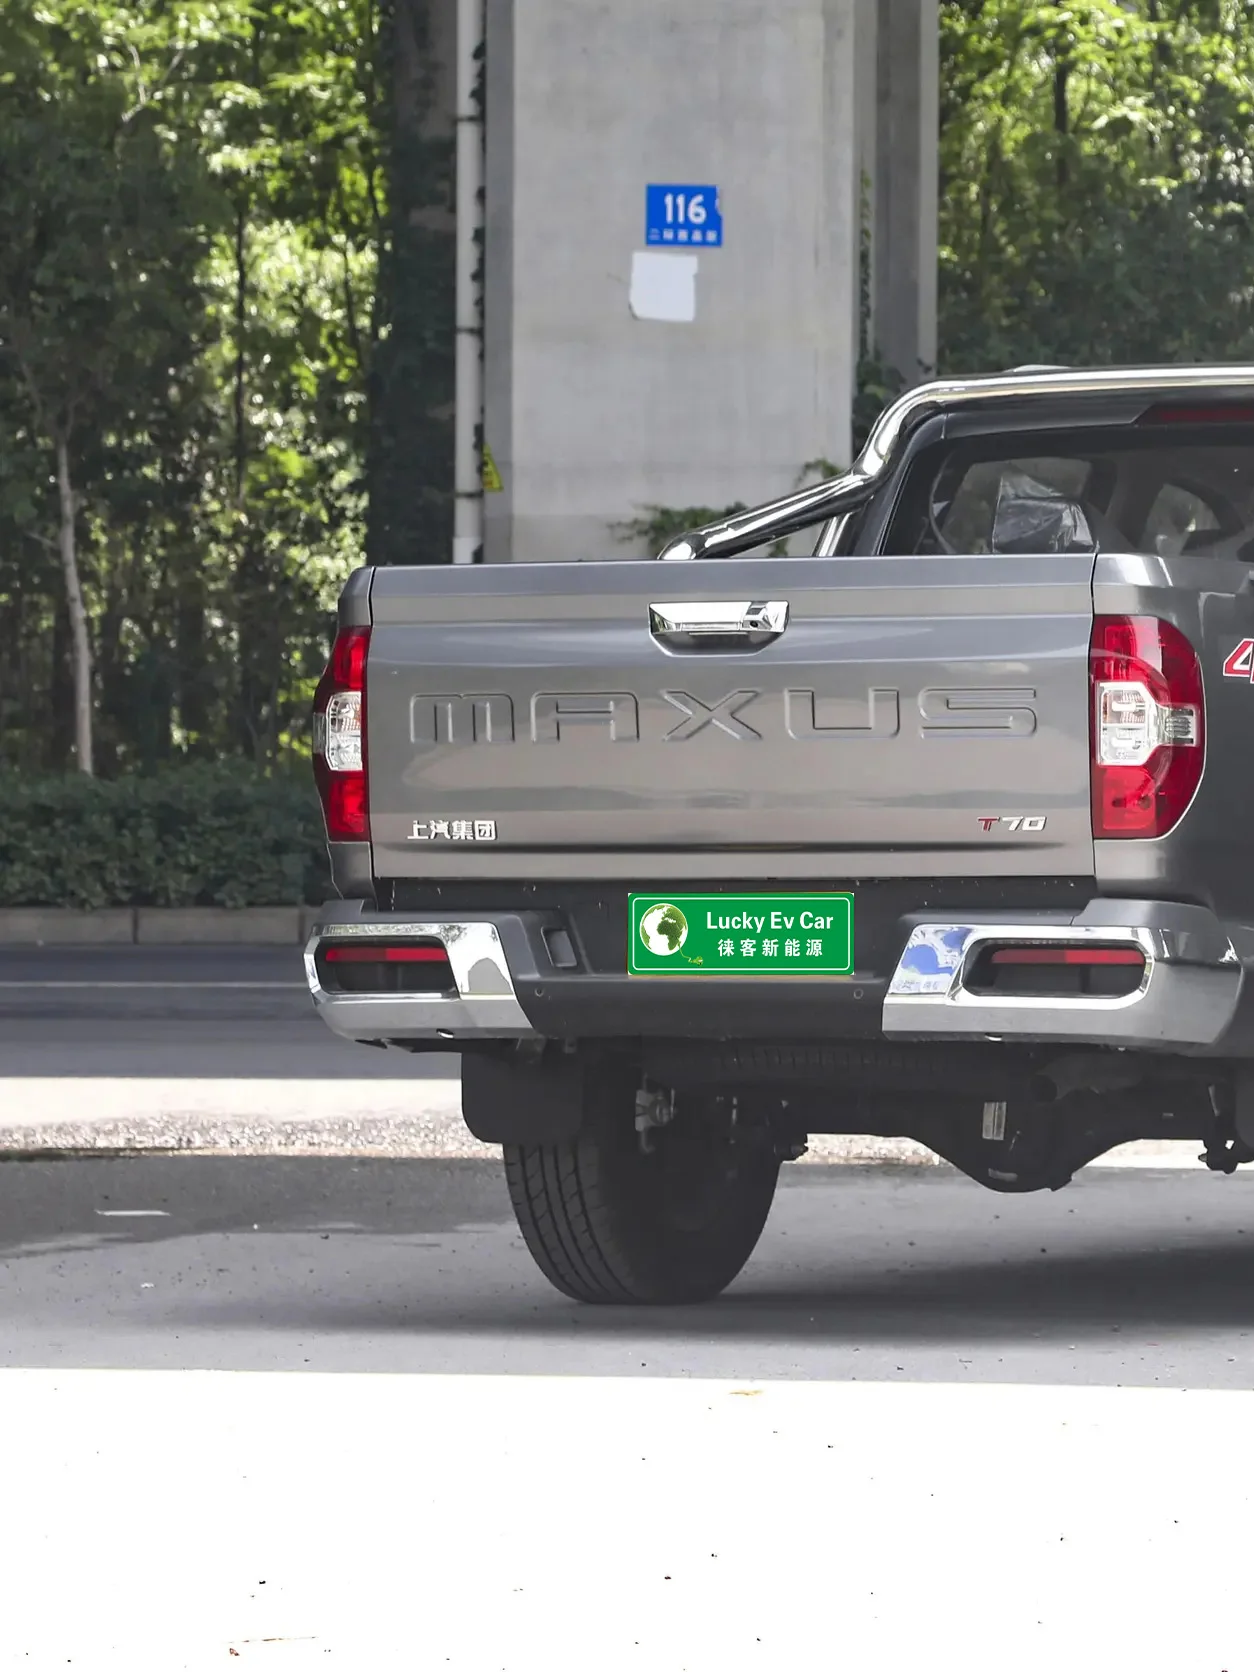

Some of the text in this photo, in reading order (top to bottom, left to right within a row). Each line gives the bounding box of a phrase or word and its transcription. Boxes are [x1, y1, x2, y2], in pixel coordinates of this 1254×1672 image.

[664, 193, 707, 225] 116
[409, 687, 1038, 742] MAXUS
[407, 820, 497, 840] 上汽集团
[977, 816, 1047, 831] T70
